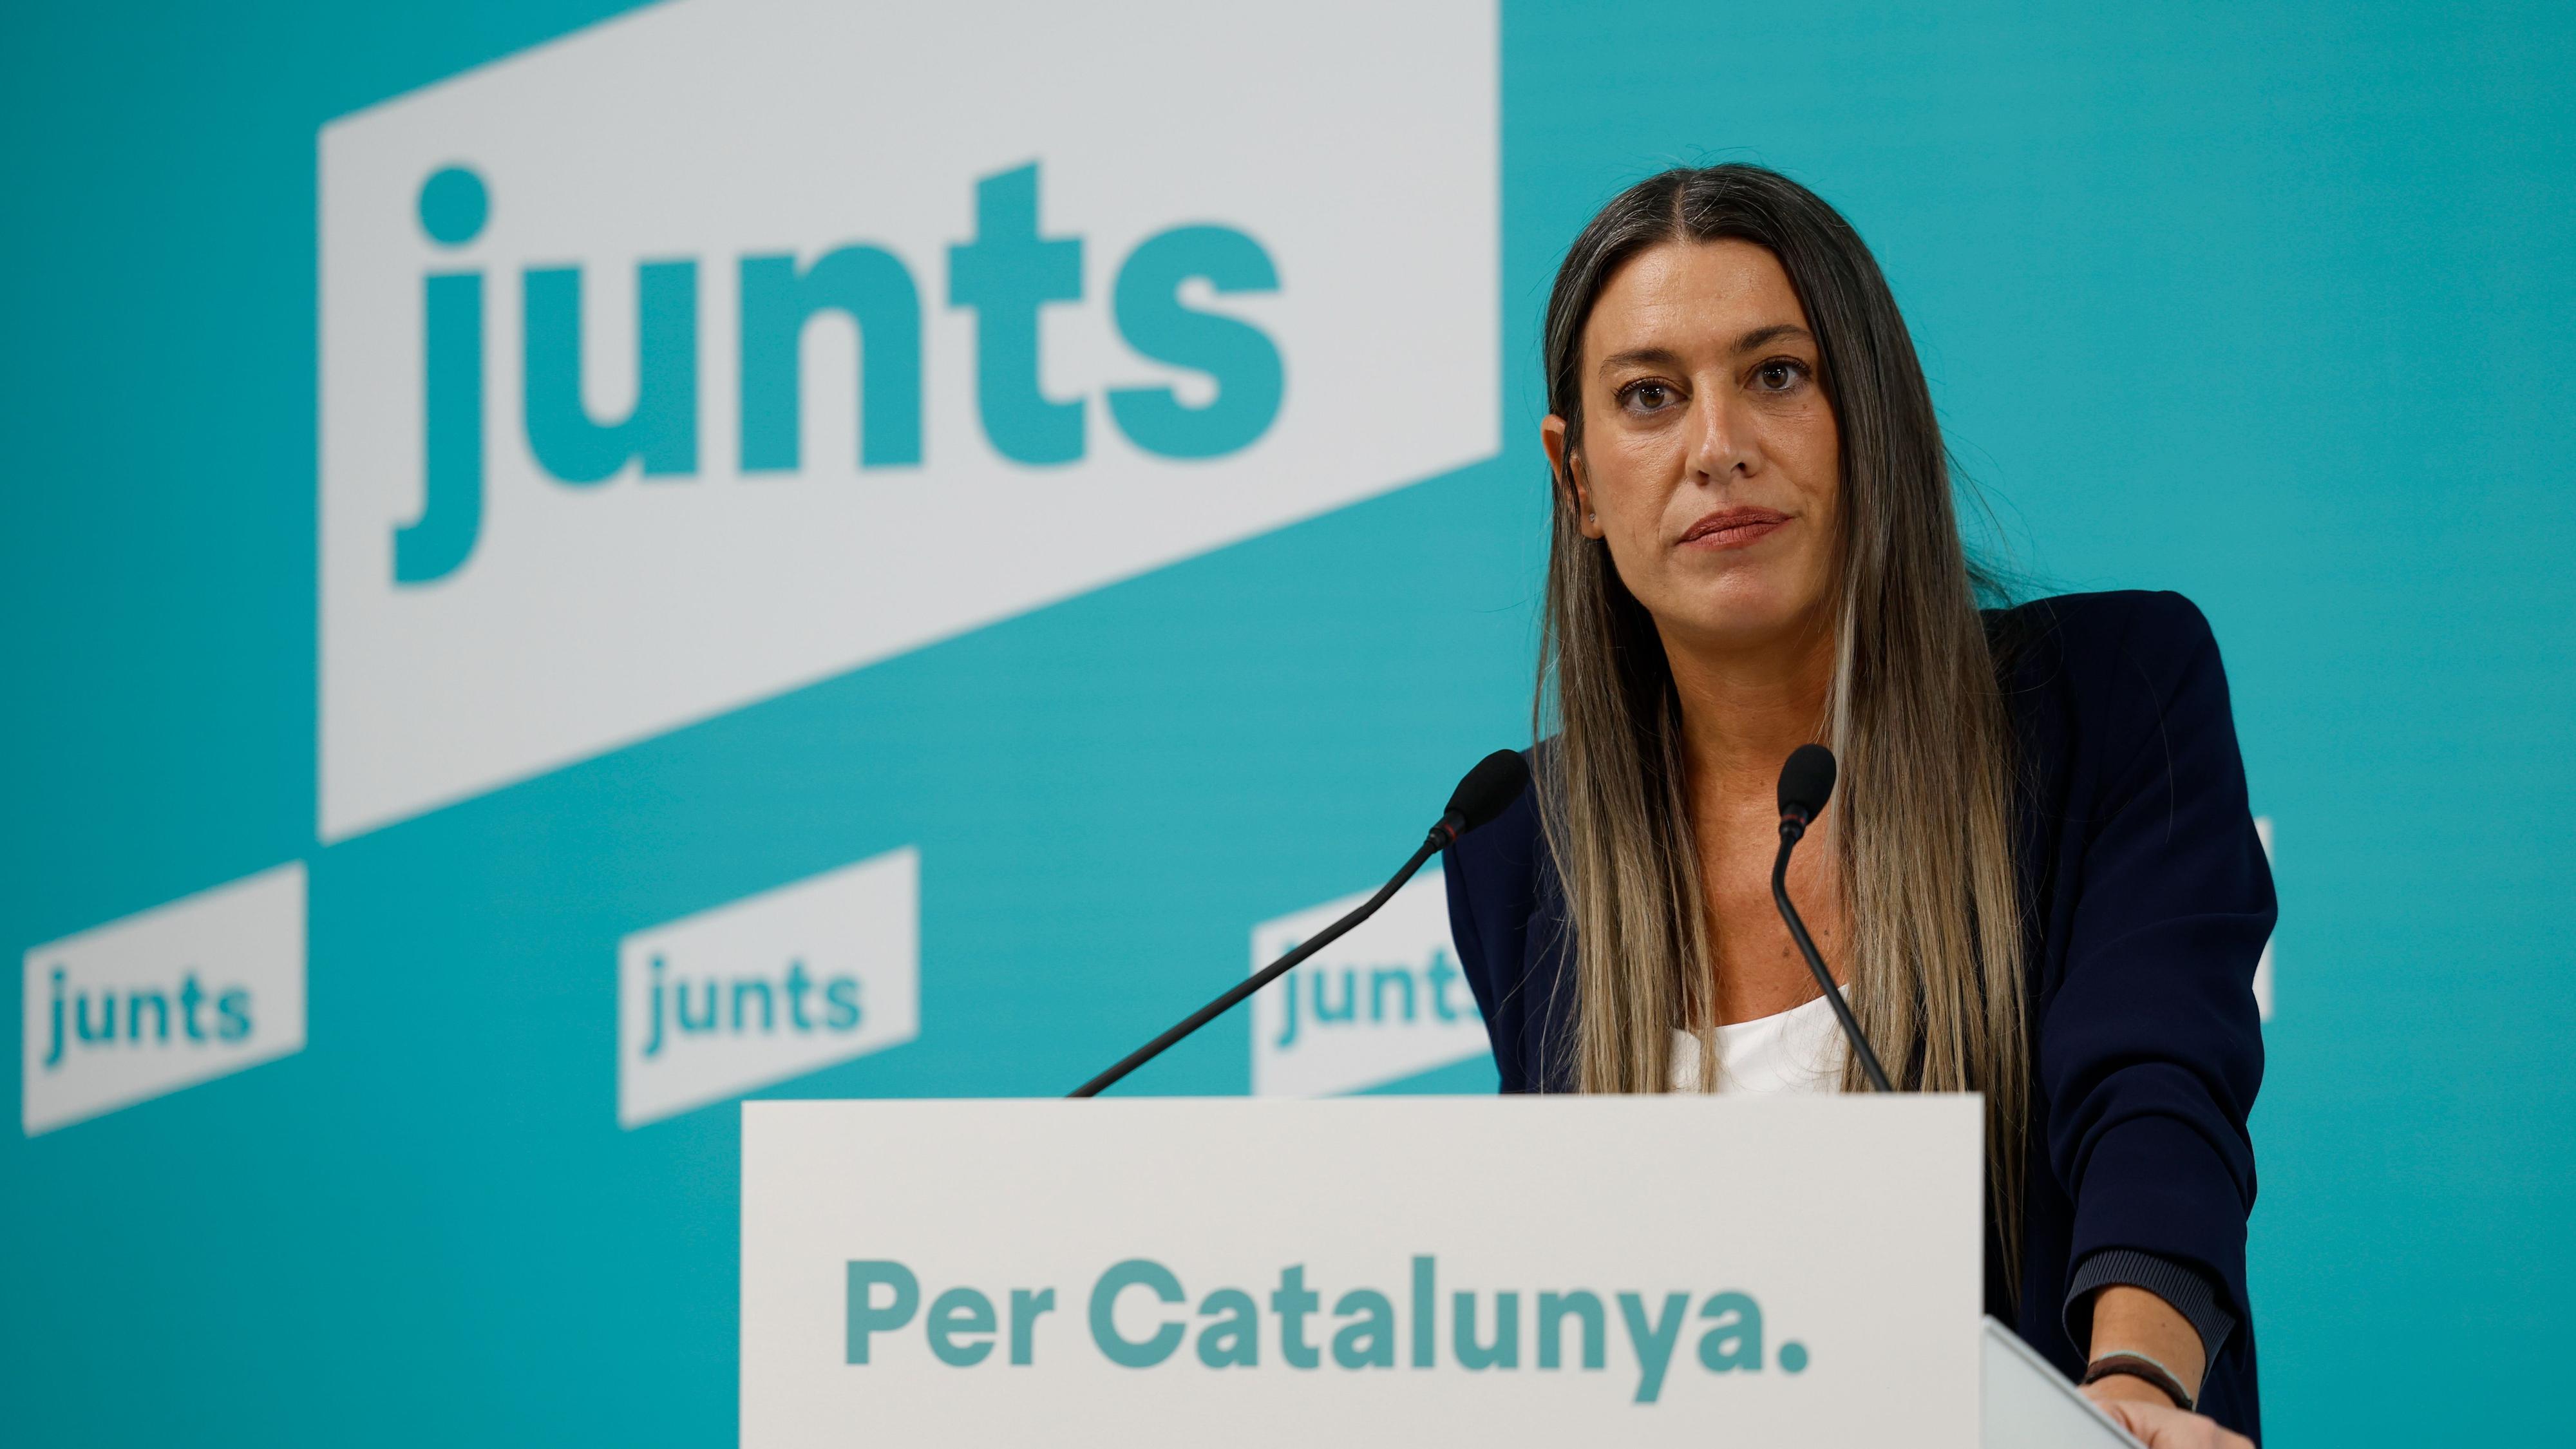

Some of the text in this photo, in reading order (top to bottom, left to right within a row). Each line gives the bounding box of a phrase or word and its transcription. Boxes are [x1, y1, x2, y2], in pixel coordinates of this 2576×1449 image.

[390, 160, 1287, 590] junts
[43, 965, 254, 1072] junts
[641, 953, 864, 1059] junts
[1275, 940, 1484, 1050] junt
[845, 1255, 1810, 1405] Per Catalunya.
